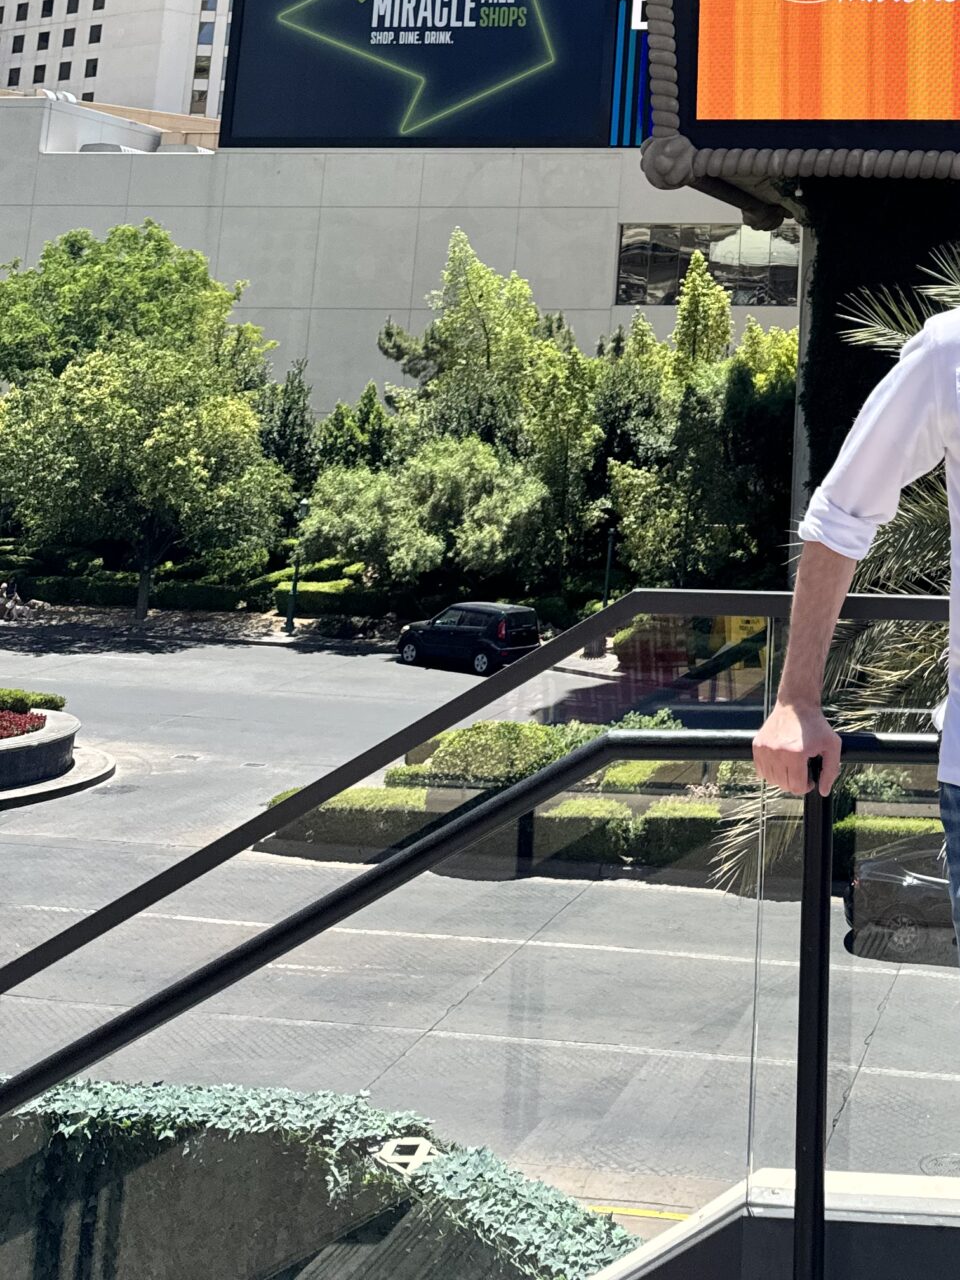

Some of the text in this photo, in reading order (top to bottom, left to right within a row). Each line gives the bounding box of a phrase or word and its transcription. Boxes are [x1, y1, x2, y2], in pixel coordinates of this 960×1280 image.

[479, 6, 527, 27] SHOPS
[370, 31, 454, 45] SHOP. DINE. DRINK.
